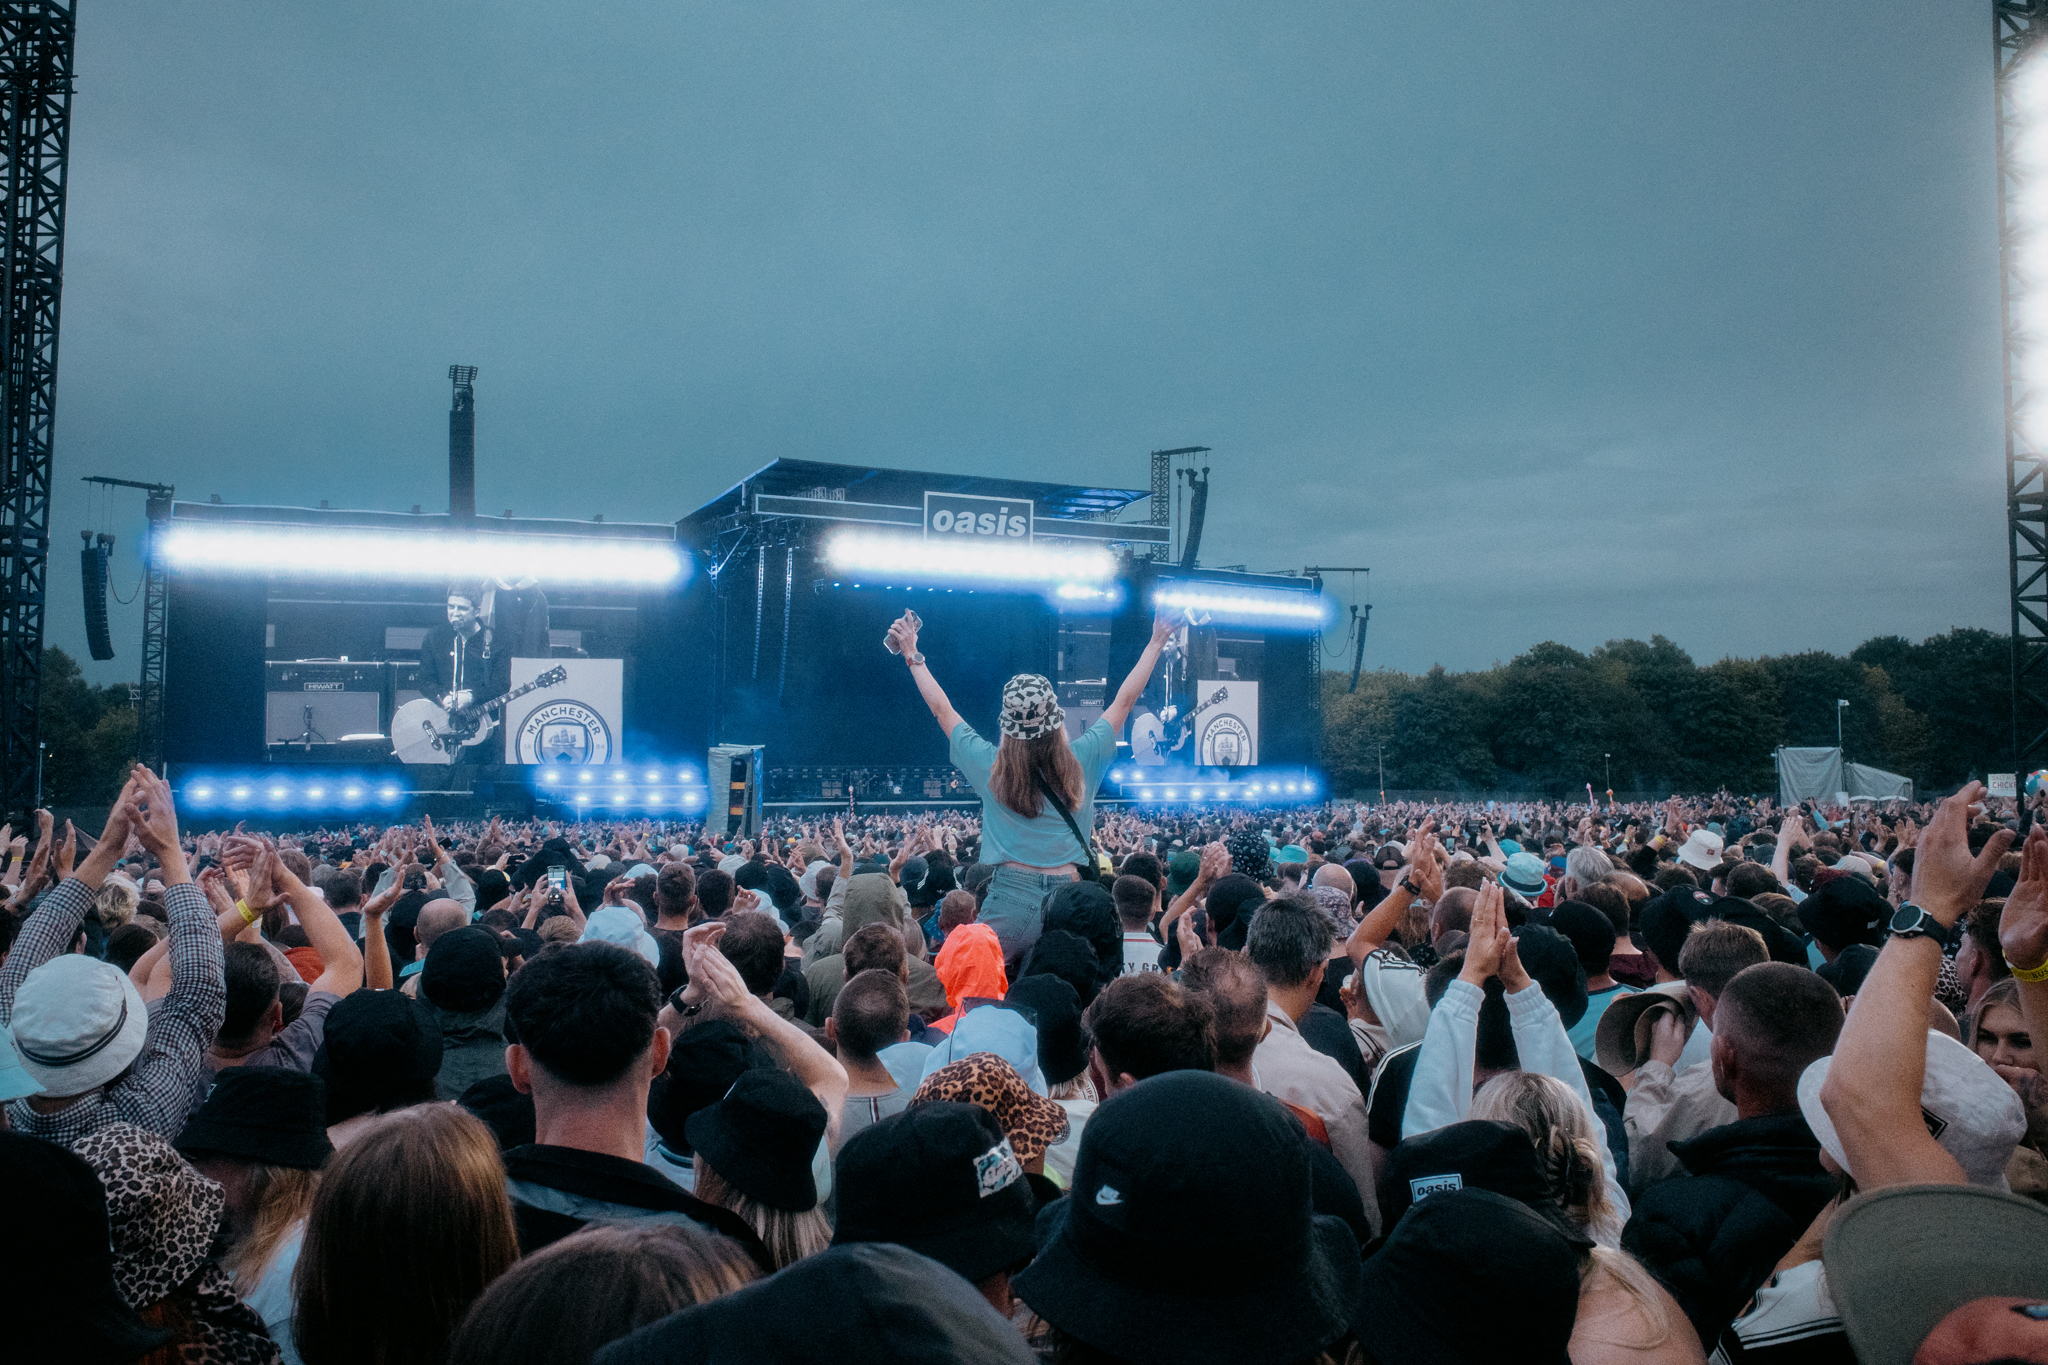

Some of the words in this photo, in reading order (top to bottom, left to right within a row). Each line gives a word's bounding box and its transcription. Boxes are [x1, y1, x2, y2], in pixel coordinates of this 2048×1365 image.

[932, 506, 1027, 537] oasis
[526, 706, 601, 735] MANCHESTER
[1206, 719, 1247, 742] MANCHESTER
[1417, 1180, 1457, 1196] oasis
